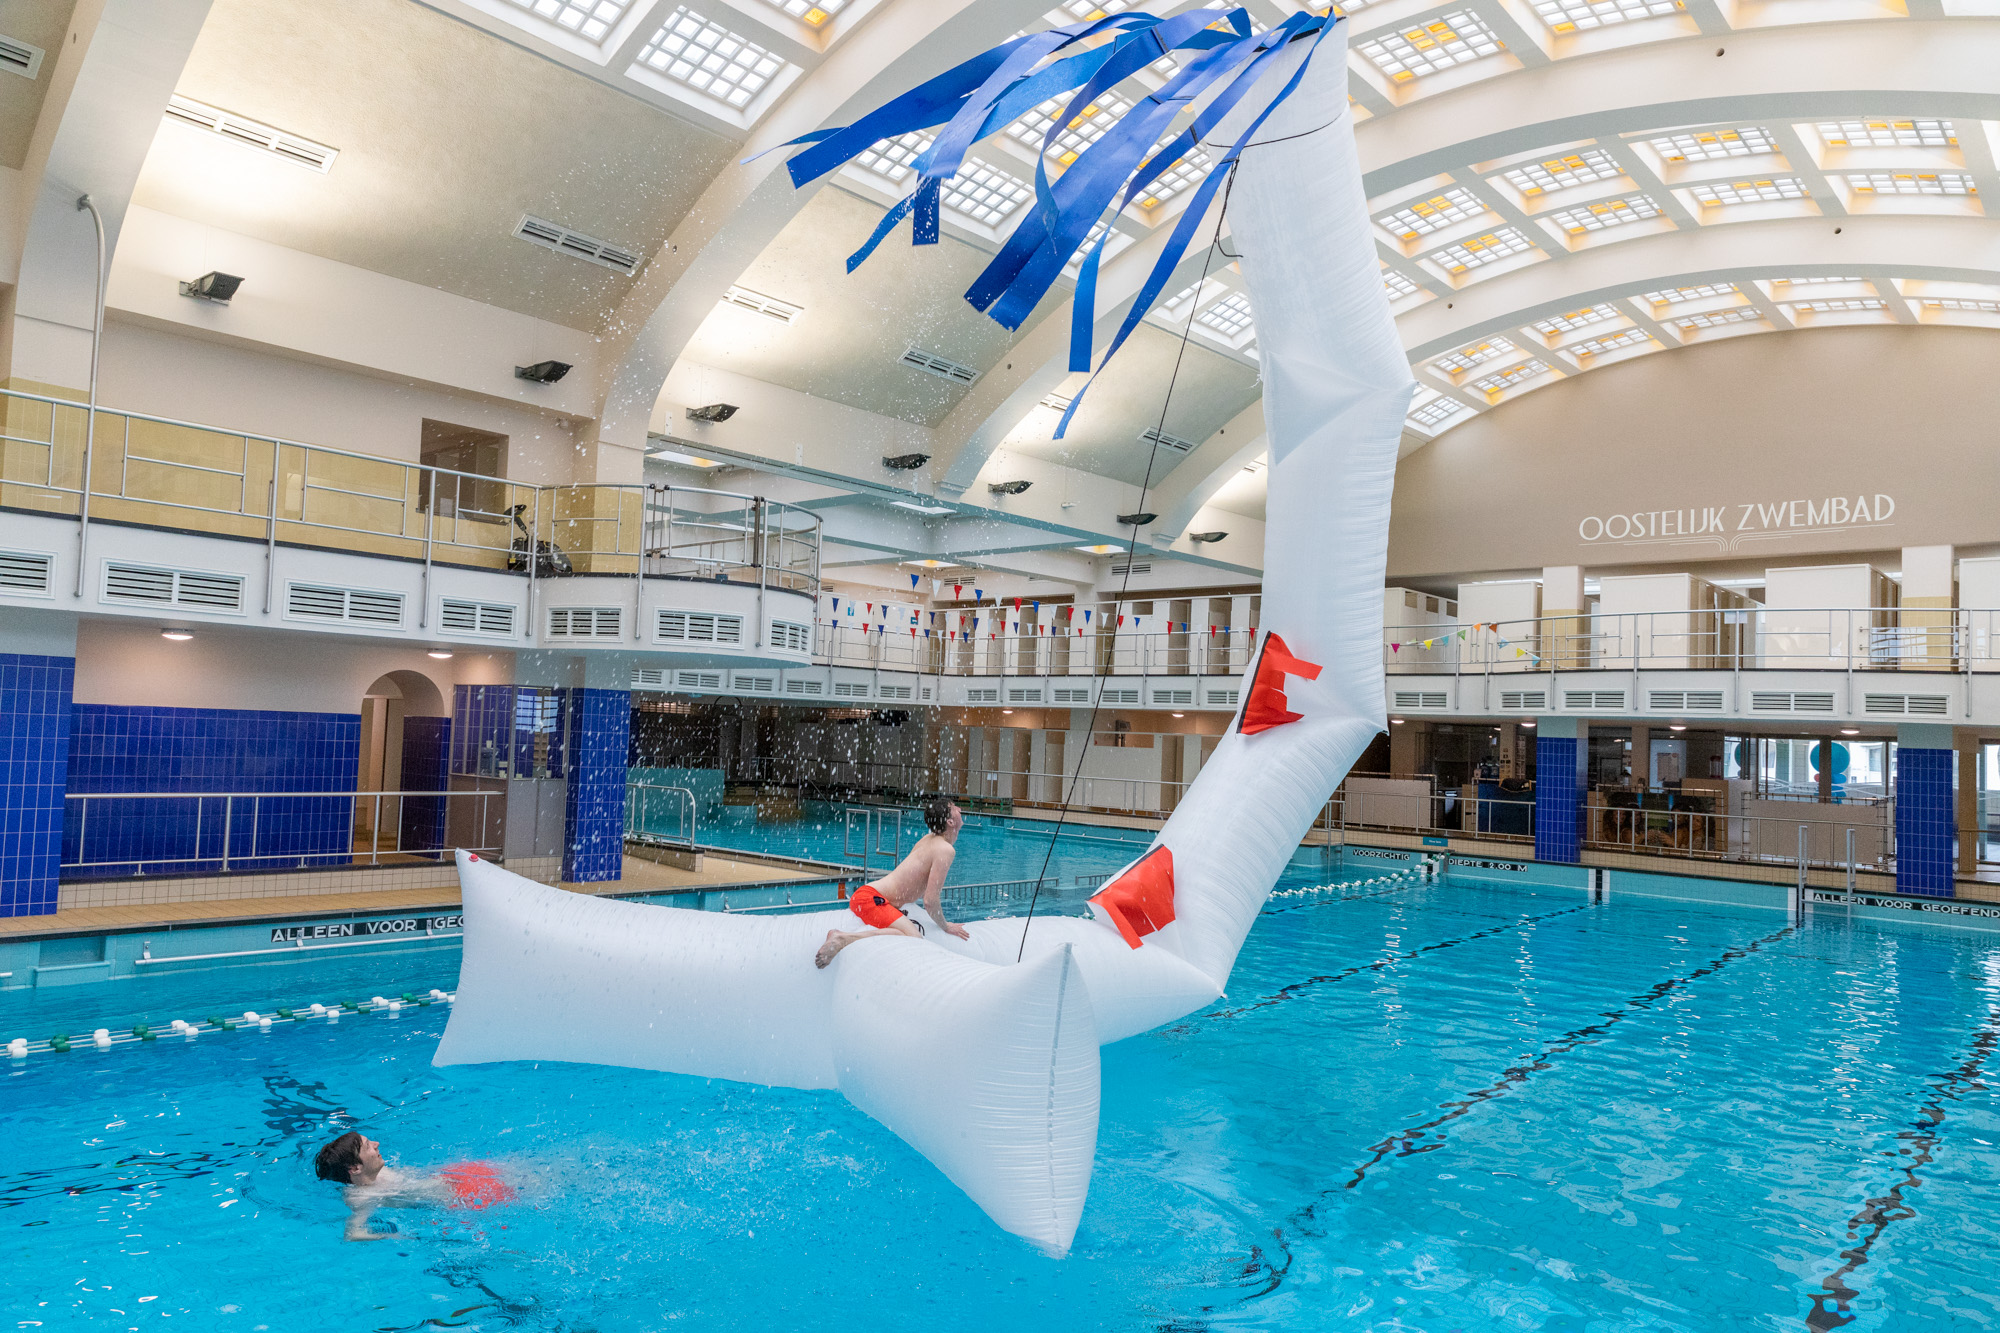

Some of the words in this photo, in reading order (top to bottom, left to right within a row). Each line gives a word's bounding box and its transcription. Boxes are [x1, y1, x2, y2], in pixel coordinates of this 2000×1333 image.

[1579, 507, 1726, 541] OOSTELIJK
[1738, 494, 1896, 530] ZWEMBAD
[1353, 849, 1410, 861] VOORZICHTIG
[1448, 858, 1483, 868] DIEPTE
[1489, 862, 1512, 871] 2.00
[1814, 893, 1867, 905] ALLEEN
[1876, 898, 1912, 910] VOOR
[1921, 903, 2000, 918] GEOEFEND
[272, 923, 353, 942] ALLEEN
[367, 919, 417, 934] VOOR
